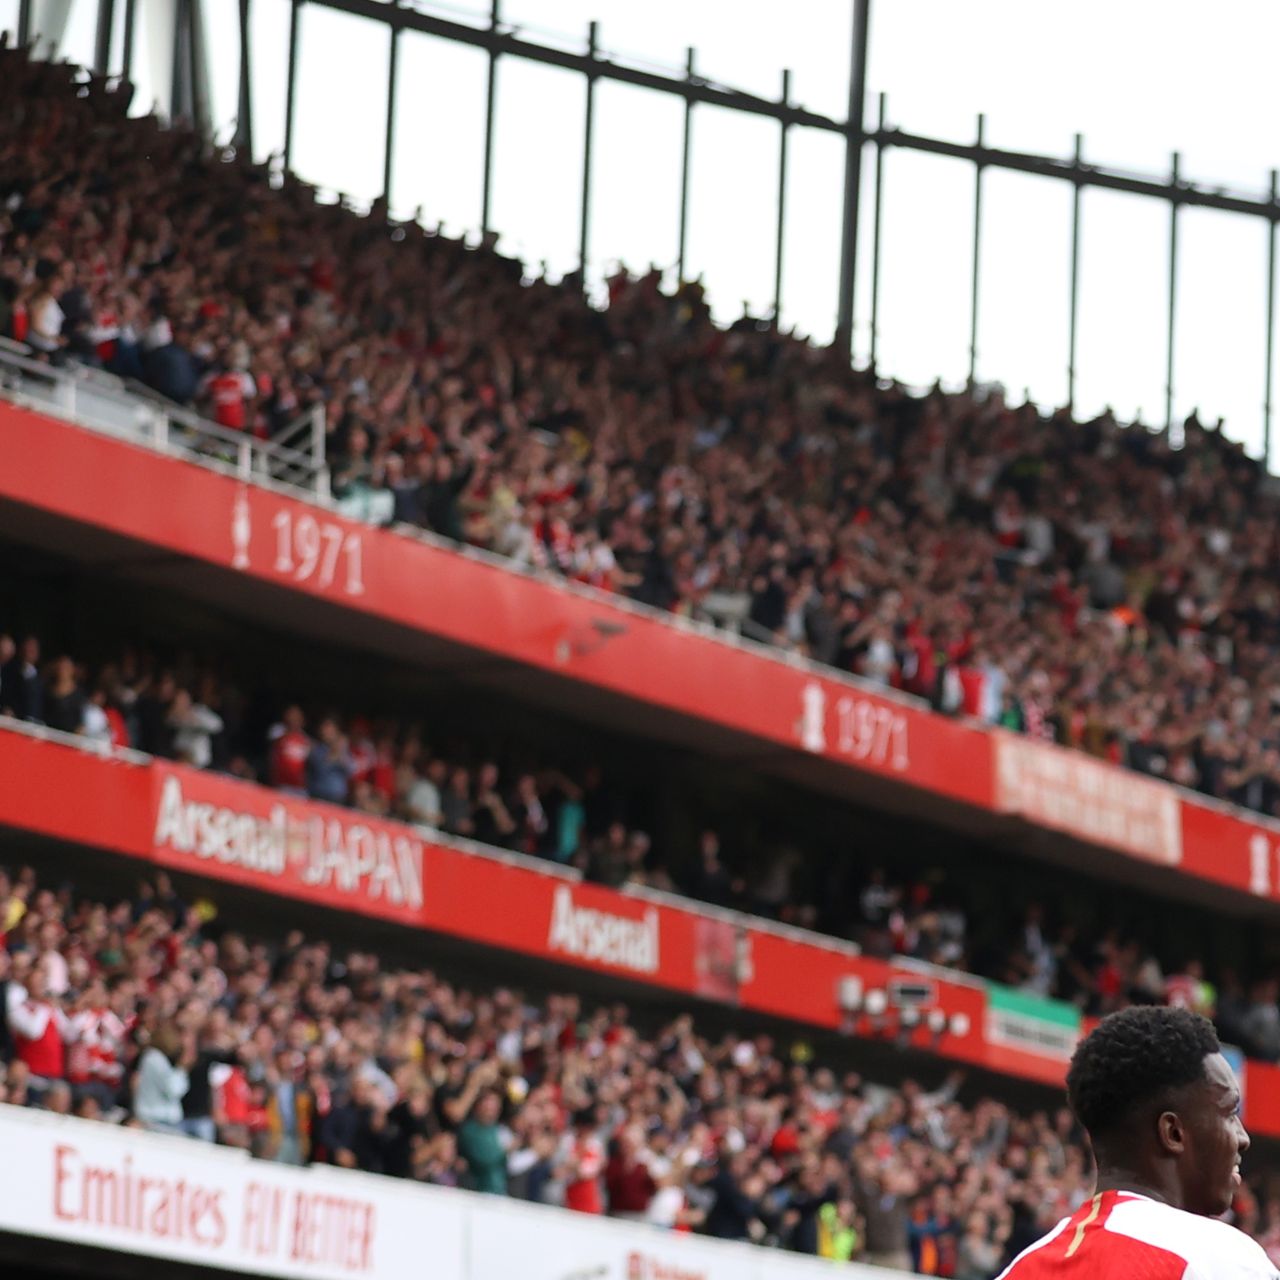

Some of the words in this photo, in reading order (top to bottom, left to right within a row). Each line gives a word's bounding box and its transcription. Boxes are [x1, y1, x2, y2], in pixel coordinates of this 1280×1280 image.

[272, 508, 364, 595] 1971
[154, 774, 286, 876] Arsenal
[304, 814, 424, 909] JAPAN
[548, 882, 660, 974] Arsenal
[53, 1142, 228, 1249] Emirates
[244, 1178, 288, 1257] FLY
[290, 1188, 377, 1271] BETTER
